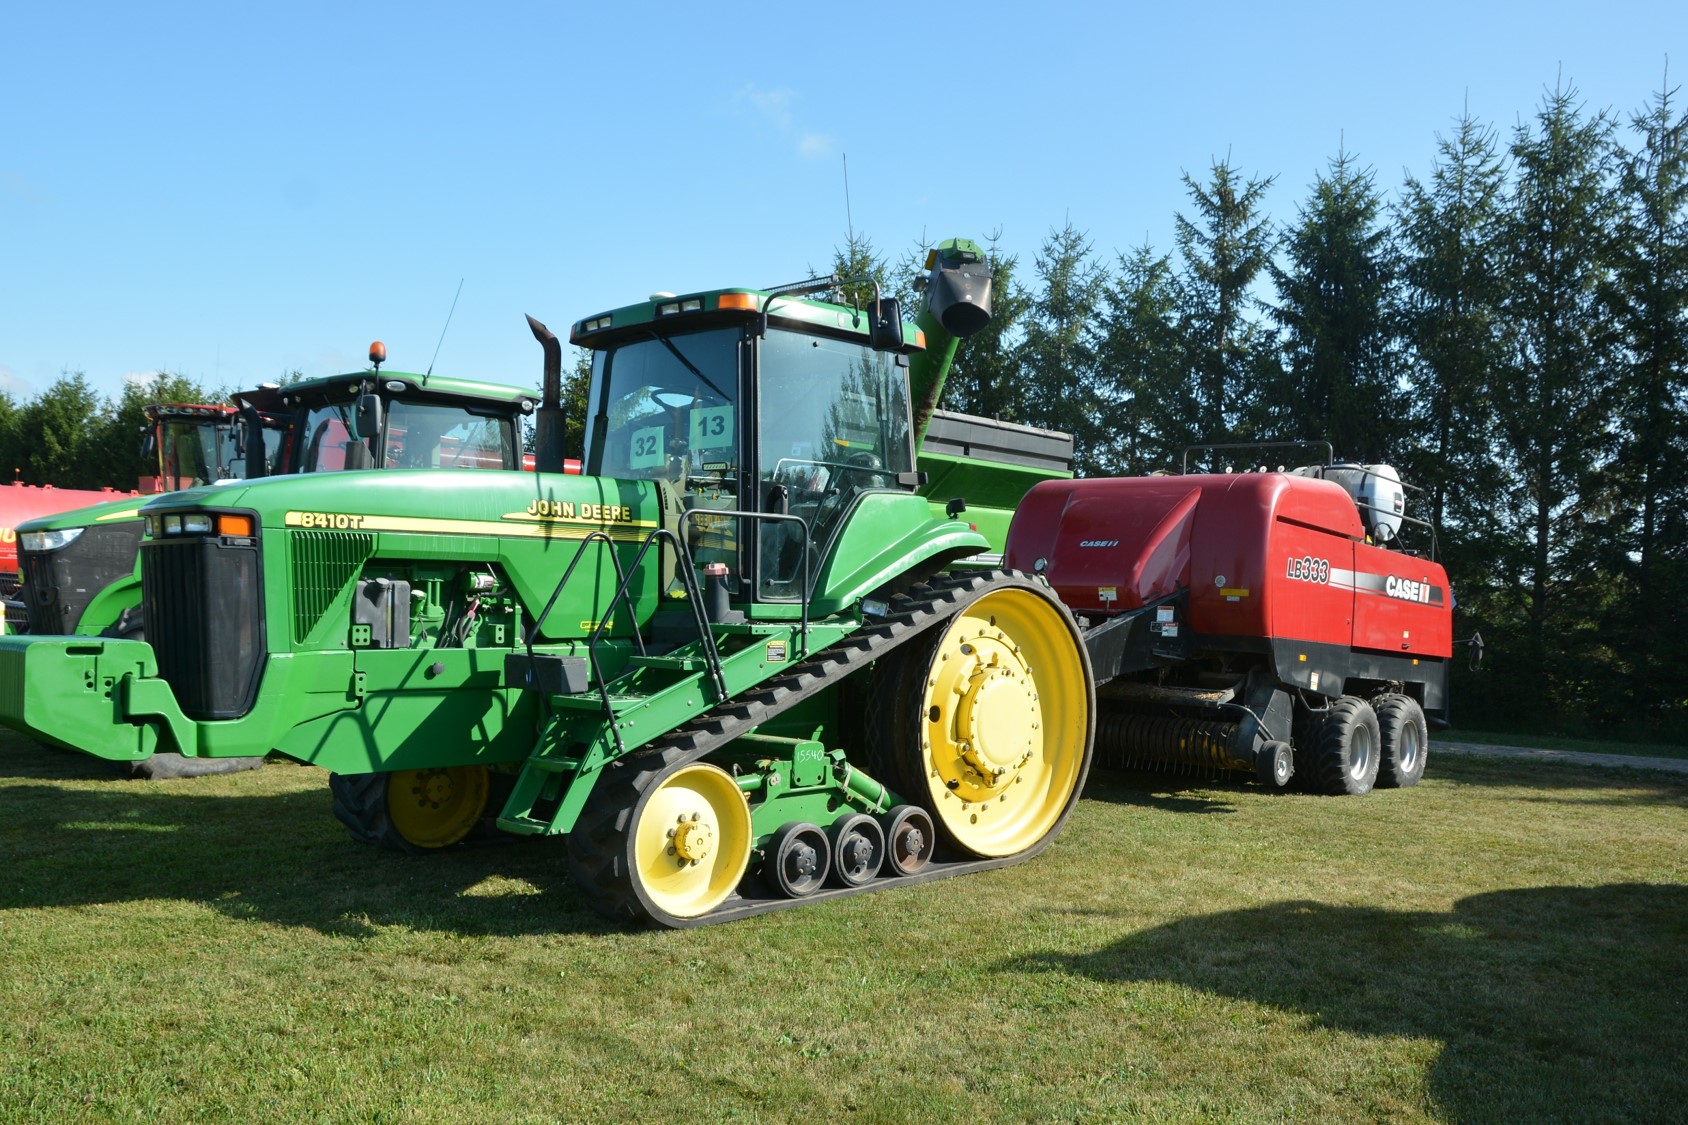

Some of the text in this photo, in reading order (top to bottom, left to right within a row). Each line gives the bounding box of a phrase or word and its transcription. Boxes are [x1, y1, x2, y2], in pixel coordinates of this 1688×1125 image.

[698, 415, 725, 437] 13
[635, 435, 657, 457] 32
[301, 512, 364, 529] 8410T
[527, 499, 632, 522] JOHN DEERE
[1286, 555, 1330, 584] LB333
[1385, 575, 1419, 601] CASE
[797, 749, 824, 764] 15540
